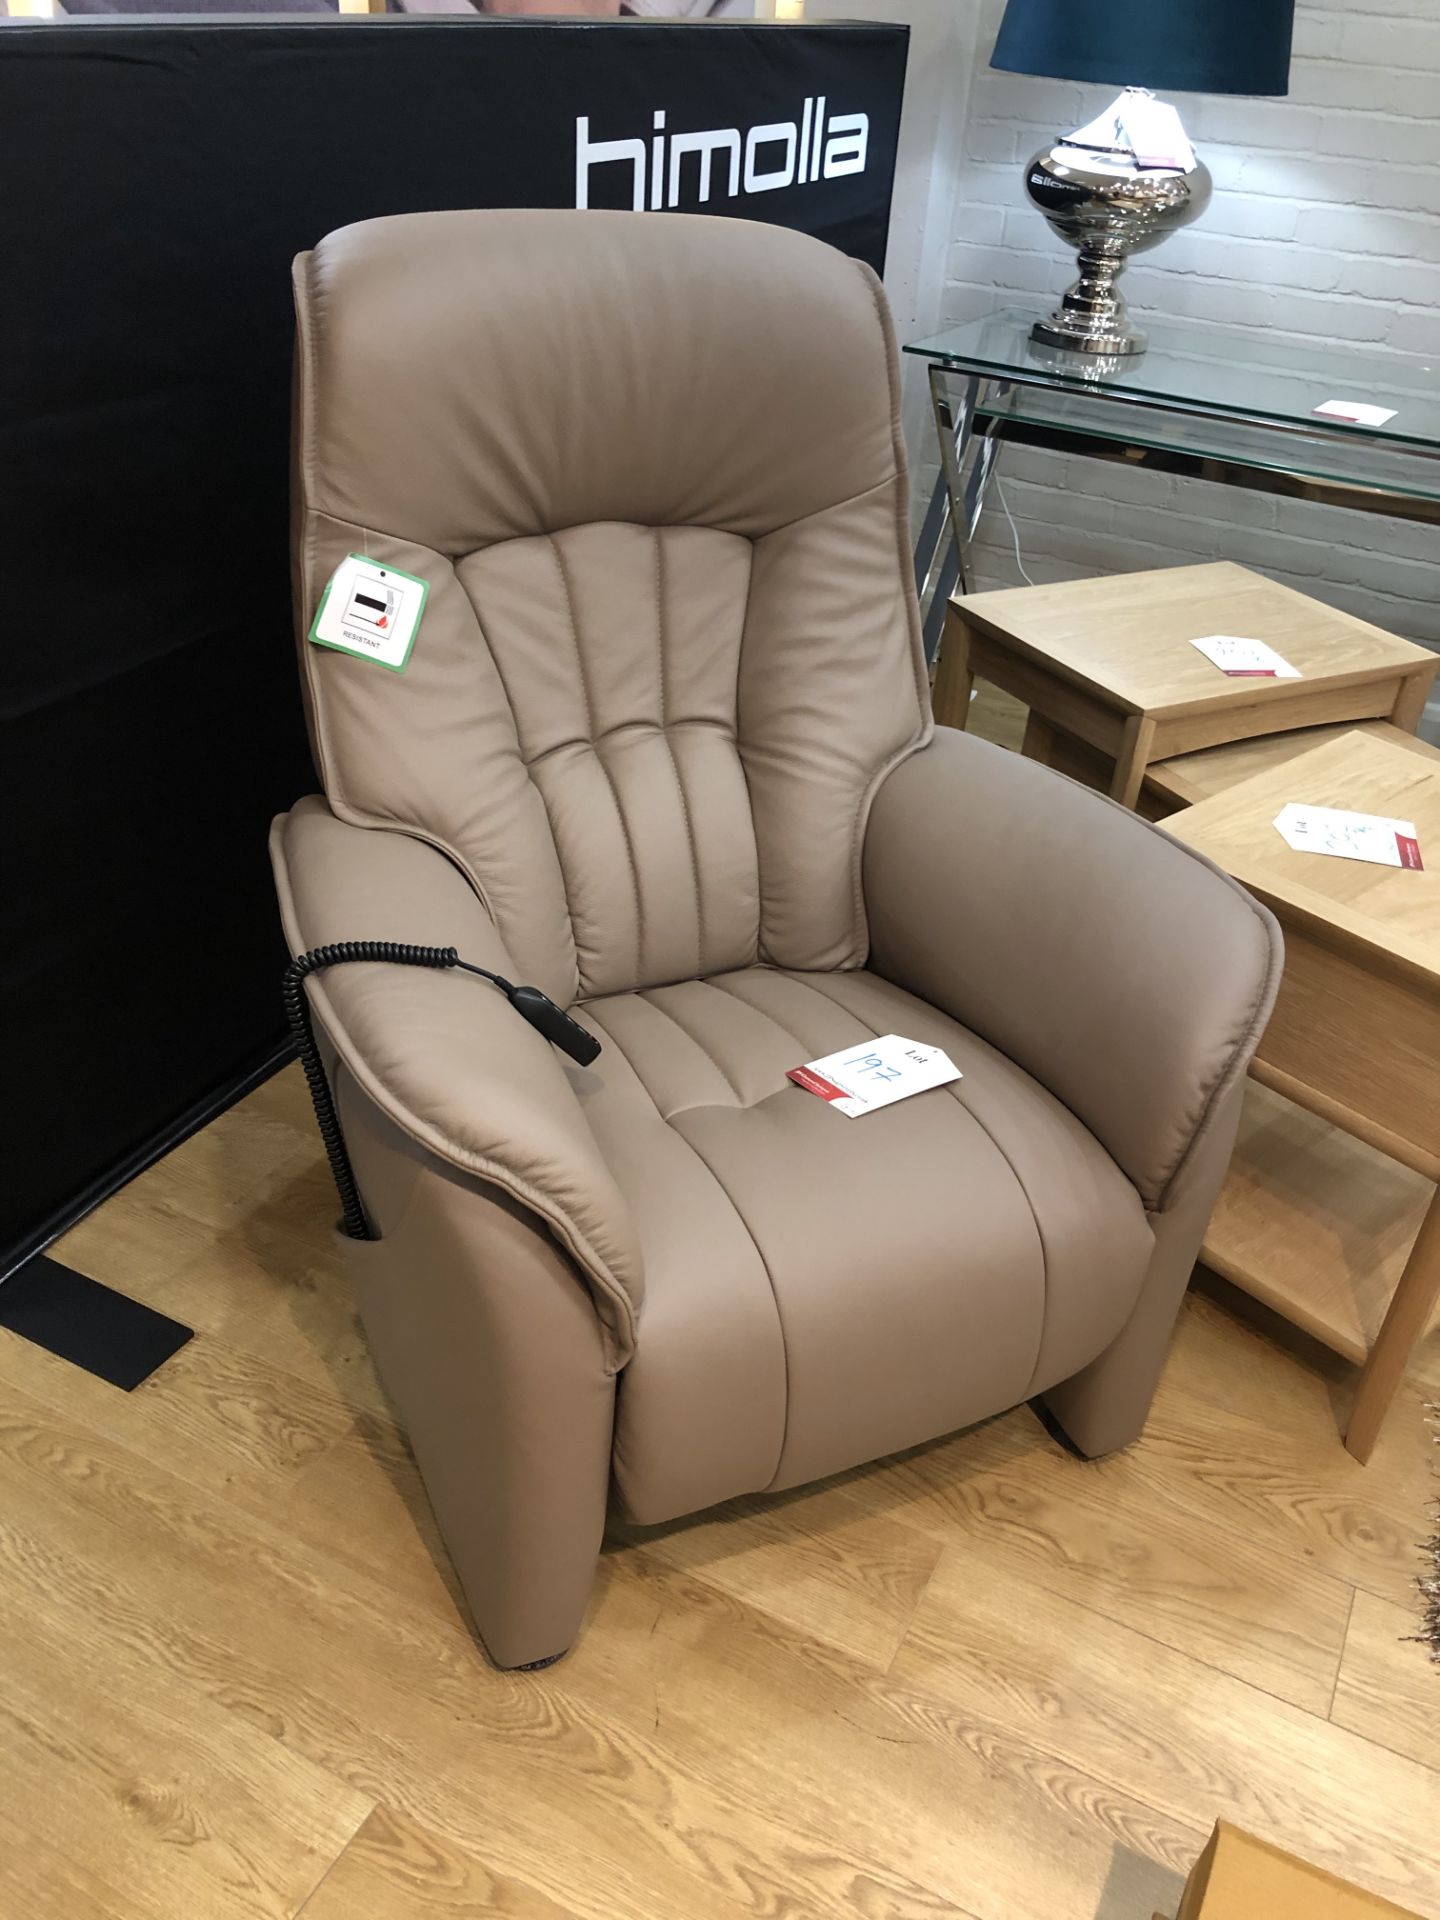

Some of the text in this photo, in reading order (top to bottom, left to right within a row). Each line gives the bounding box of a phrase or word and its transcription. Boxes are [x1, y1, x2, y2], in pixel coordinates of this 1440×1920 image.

[576, 96, 869, 212] himolla
[342, 630, 381, 648] RESISTANT
[843, 1053, 902, 1082] 197
[905, 1049, 929, 1064] Lot
